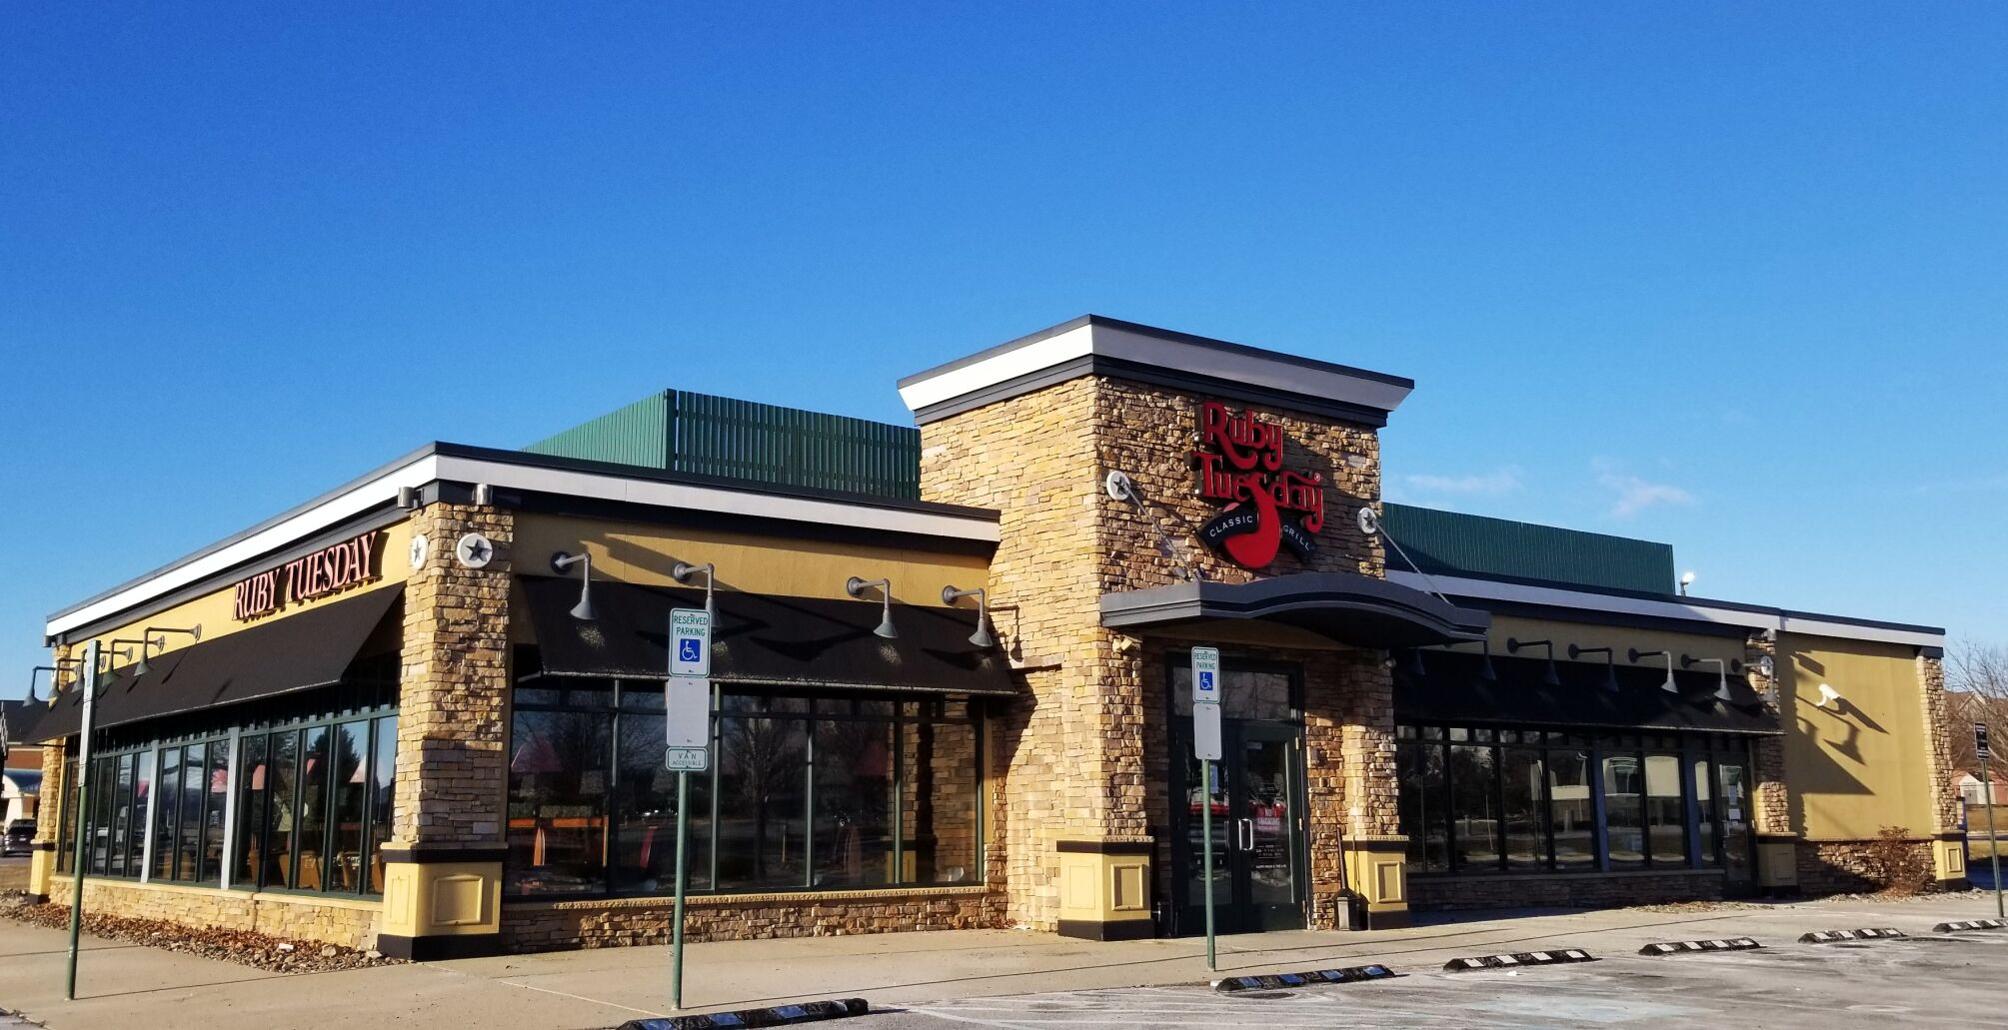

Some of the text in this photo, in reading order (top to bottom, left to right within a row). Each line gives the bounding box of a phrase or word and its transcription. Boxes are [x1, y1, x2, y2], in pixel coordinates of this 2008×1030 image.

[1203, 401, 1284, 471] Ruby
[1193, 450, 1324, 568] Tuesday
[1210, 515, 1310, 551] CLASSIC GRILL
[234, 532, 377, 620] RUBY TUESDAY
[673, 615, 709, 626] RESERVED
[676, 626, 706, 637] PARKING
